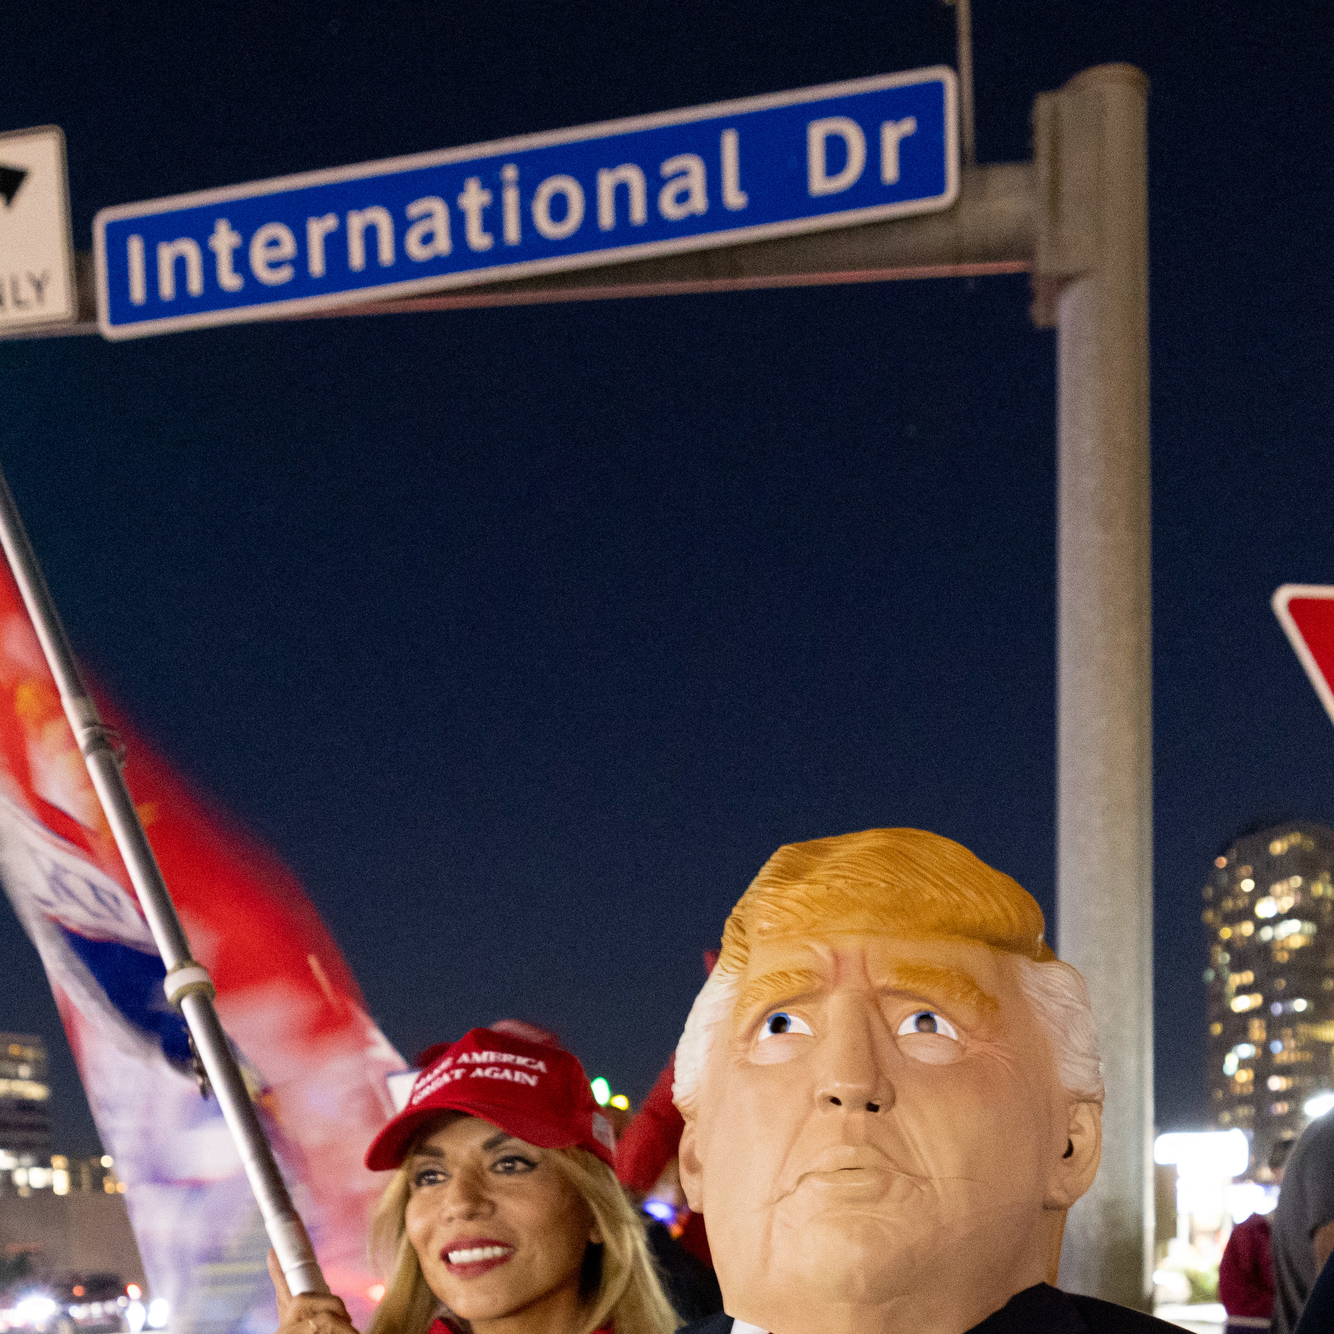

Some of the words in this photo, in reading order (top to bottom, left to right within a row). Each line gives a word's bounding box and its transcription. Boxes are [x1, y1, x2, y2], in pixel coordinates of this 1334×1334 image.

[126, 127, 748, 306] International
[806, 116, 917, 197] Dr
[456, 1050, 547, 1074] AMERICA
[469, 1066, 539, 1088] AGAIN
